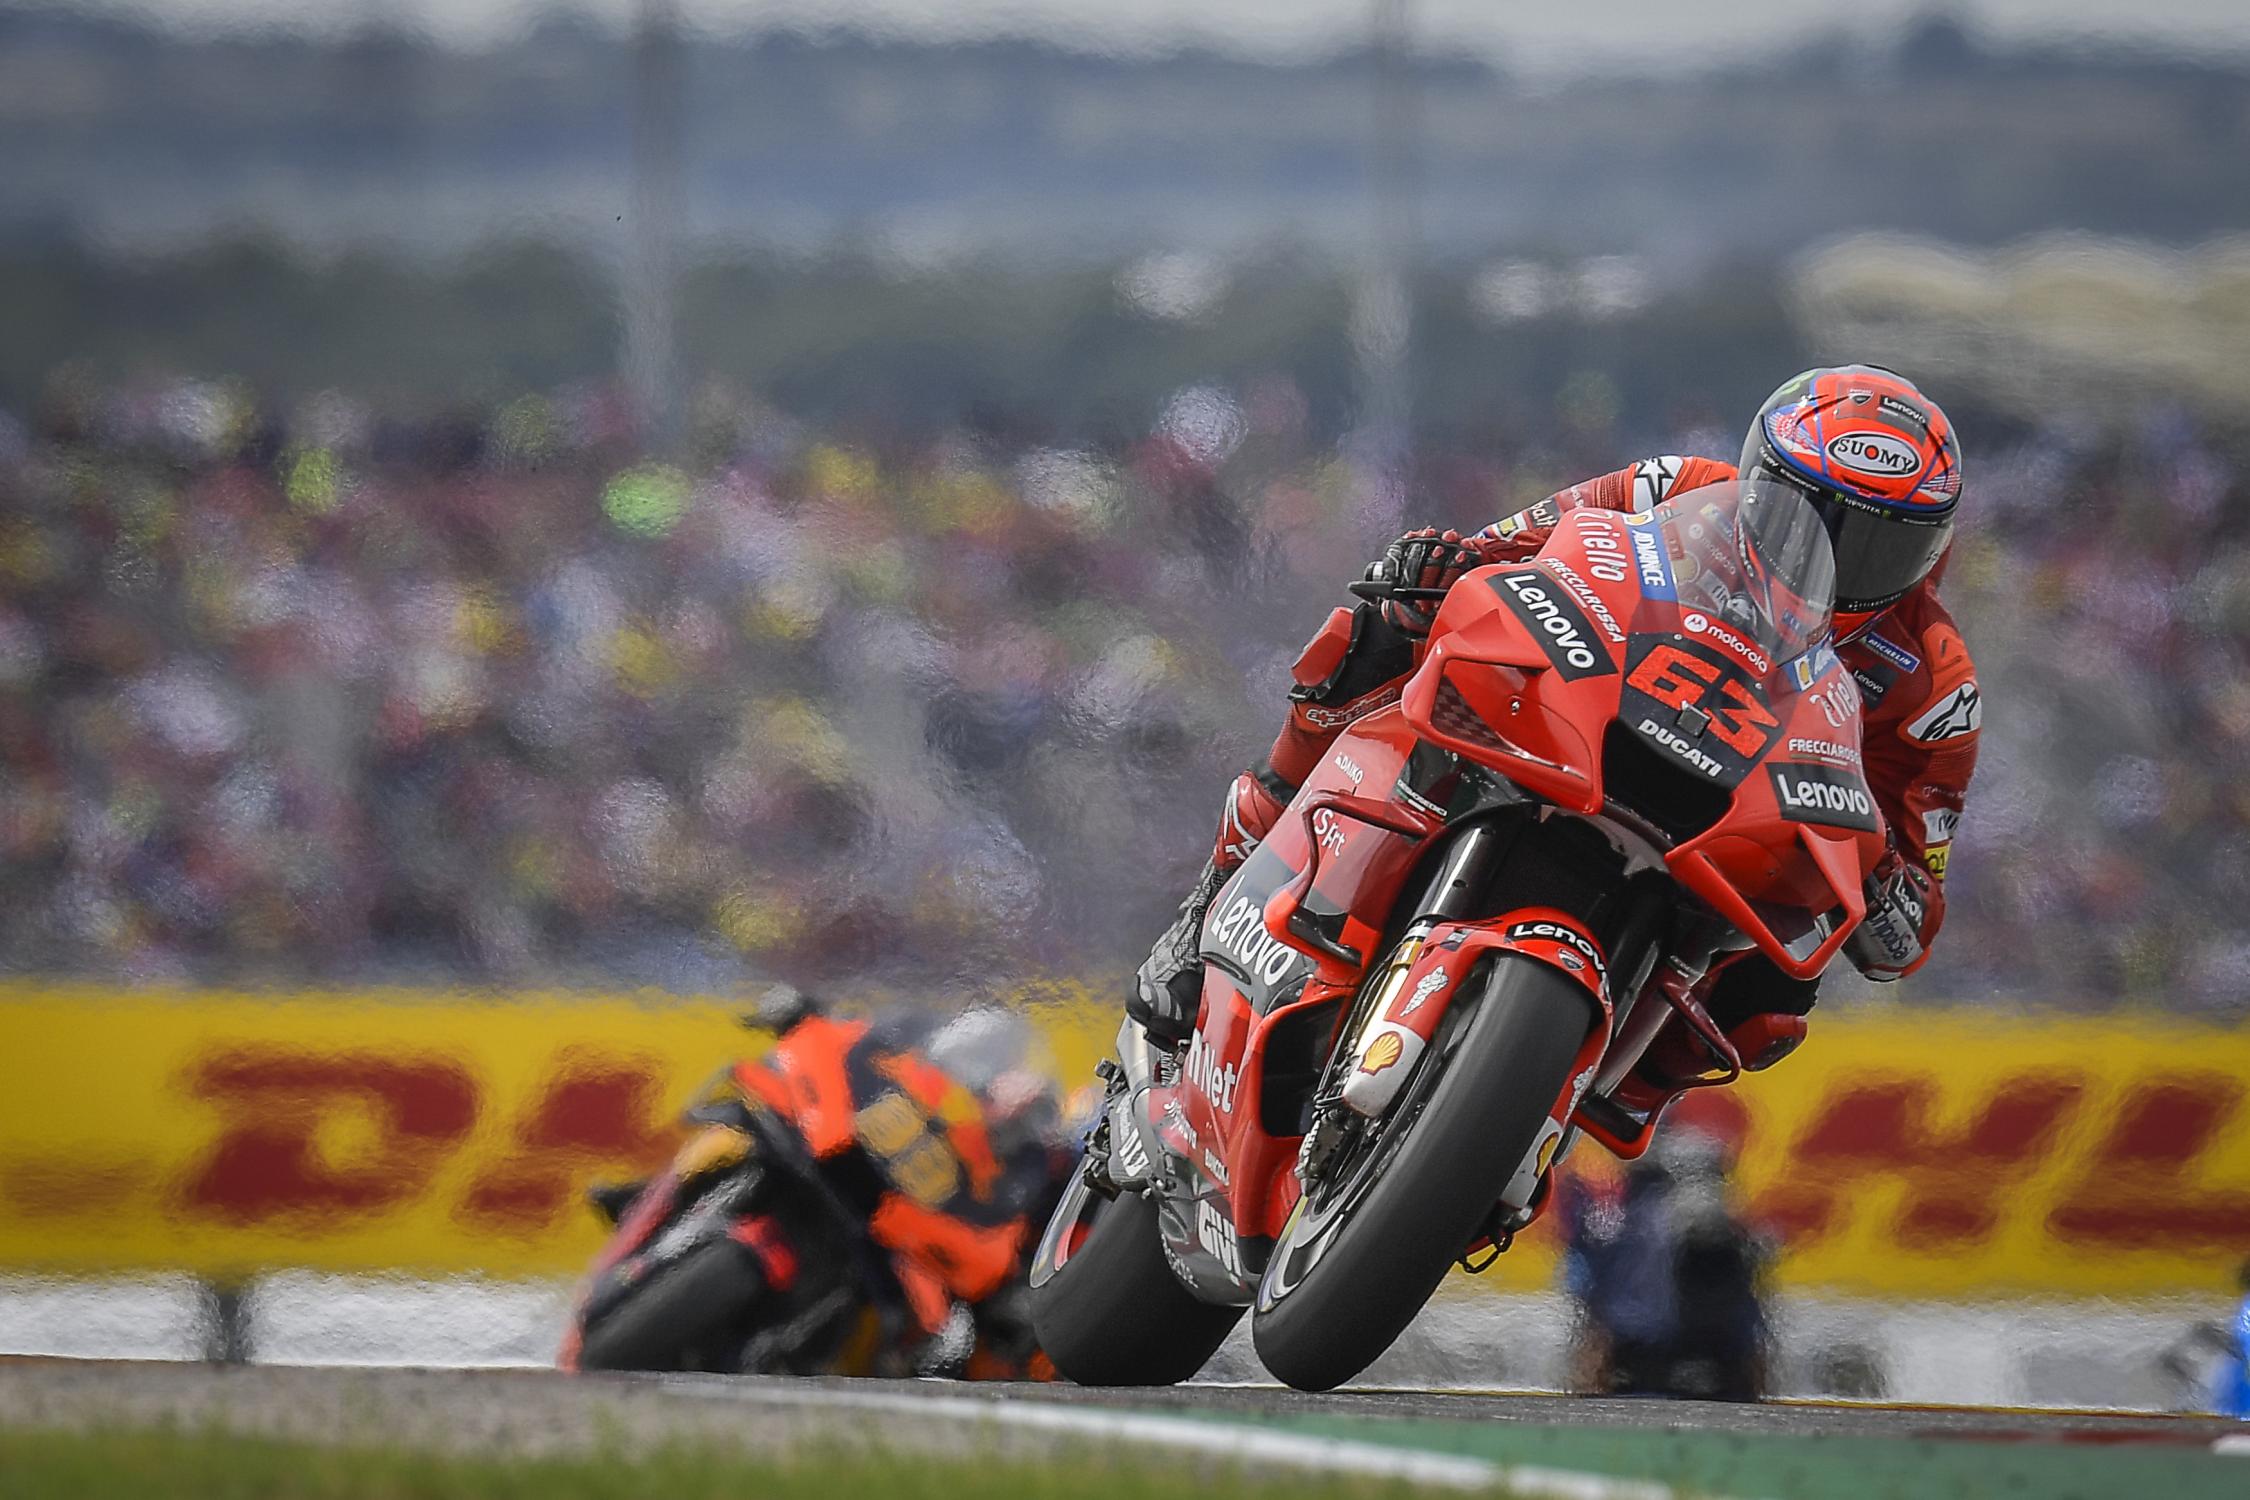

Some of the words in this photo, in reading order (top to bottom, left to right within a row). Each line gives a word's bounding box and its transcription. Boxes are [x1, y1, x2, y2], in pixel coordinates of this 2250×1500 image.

[1883, 397, 1926, 423] Lenovo
[1837, 438, 1913, 473] SUOMY
[1632, 530, 1665, 587] ADVANCE
[1504, 574, 1595, 670] Lenovo
[1541, 558, 1627, 643] FRECCIAROSSA
[1707, 625, 1767, 673] motorola
[1867, 639, 1911, 666] MICHELIN
[1626, 644, 1780, 759] 63
[1853, 669, 1884, 694] Lenovo
[1638, 719, 1724, 778] DUCATI
[1777, 774, 1869, 815] Lenovo
[1210, 874, 1298, 986] Lenovo
